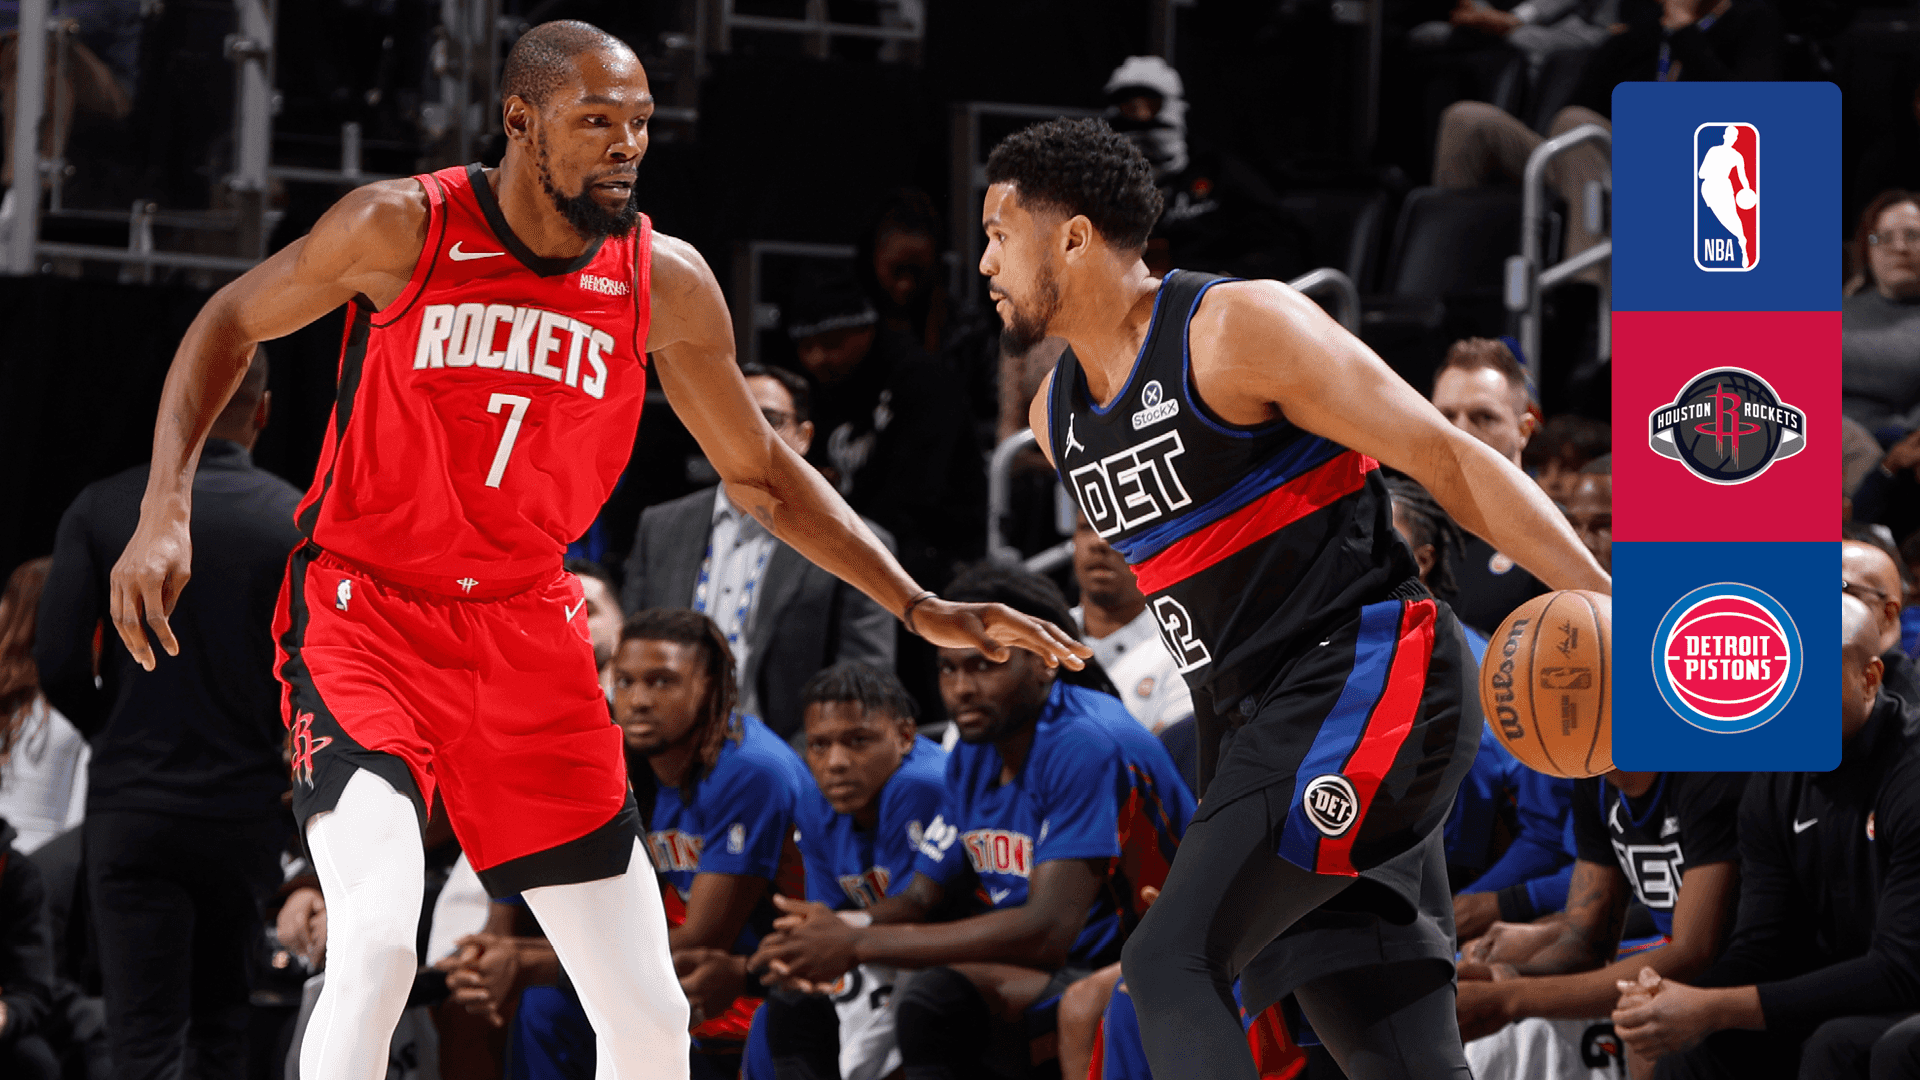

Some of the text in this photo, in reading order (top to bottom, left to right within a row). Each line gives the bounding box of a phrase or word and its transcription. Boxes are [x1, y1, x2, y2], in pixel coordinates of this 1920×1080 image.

[580, 272, 630, 290] MEMORIAL
[580, 281, 630, 296] HERMANN
[413, 302, 616, 400] ROCKETS
[486, 392, 531, 489] 7
[1133, 400, 1178, 427] StockX
[1069, 428, 1193, 539] DET
[1491, 617, 1532, 743] Wilson
[1314, 788, 1351, 822] DET
